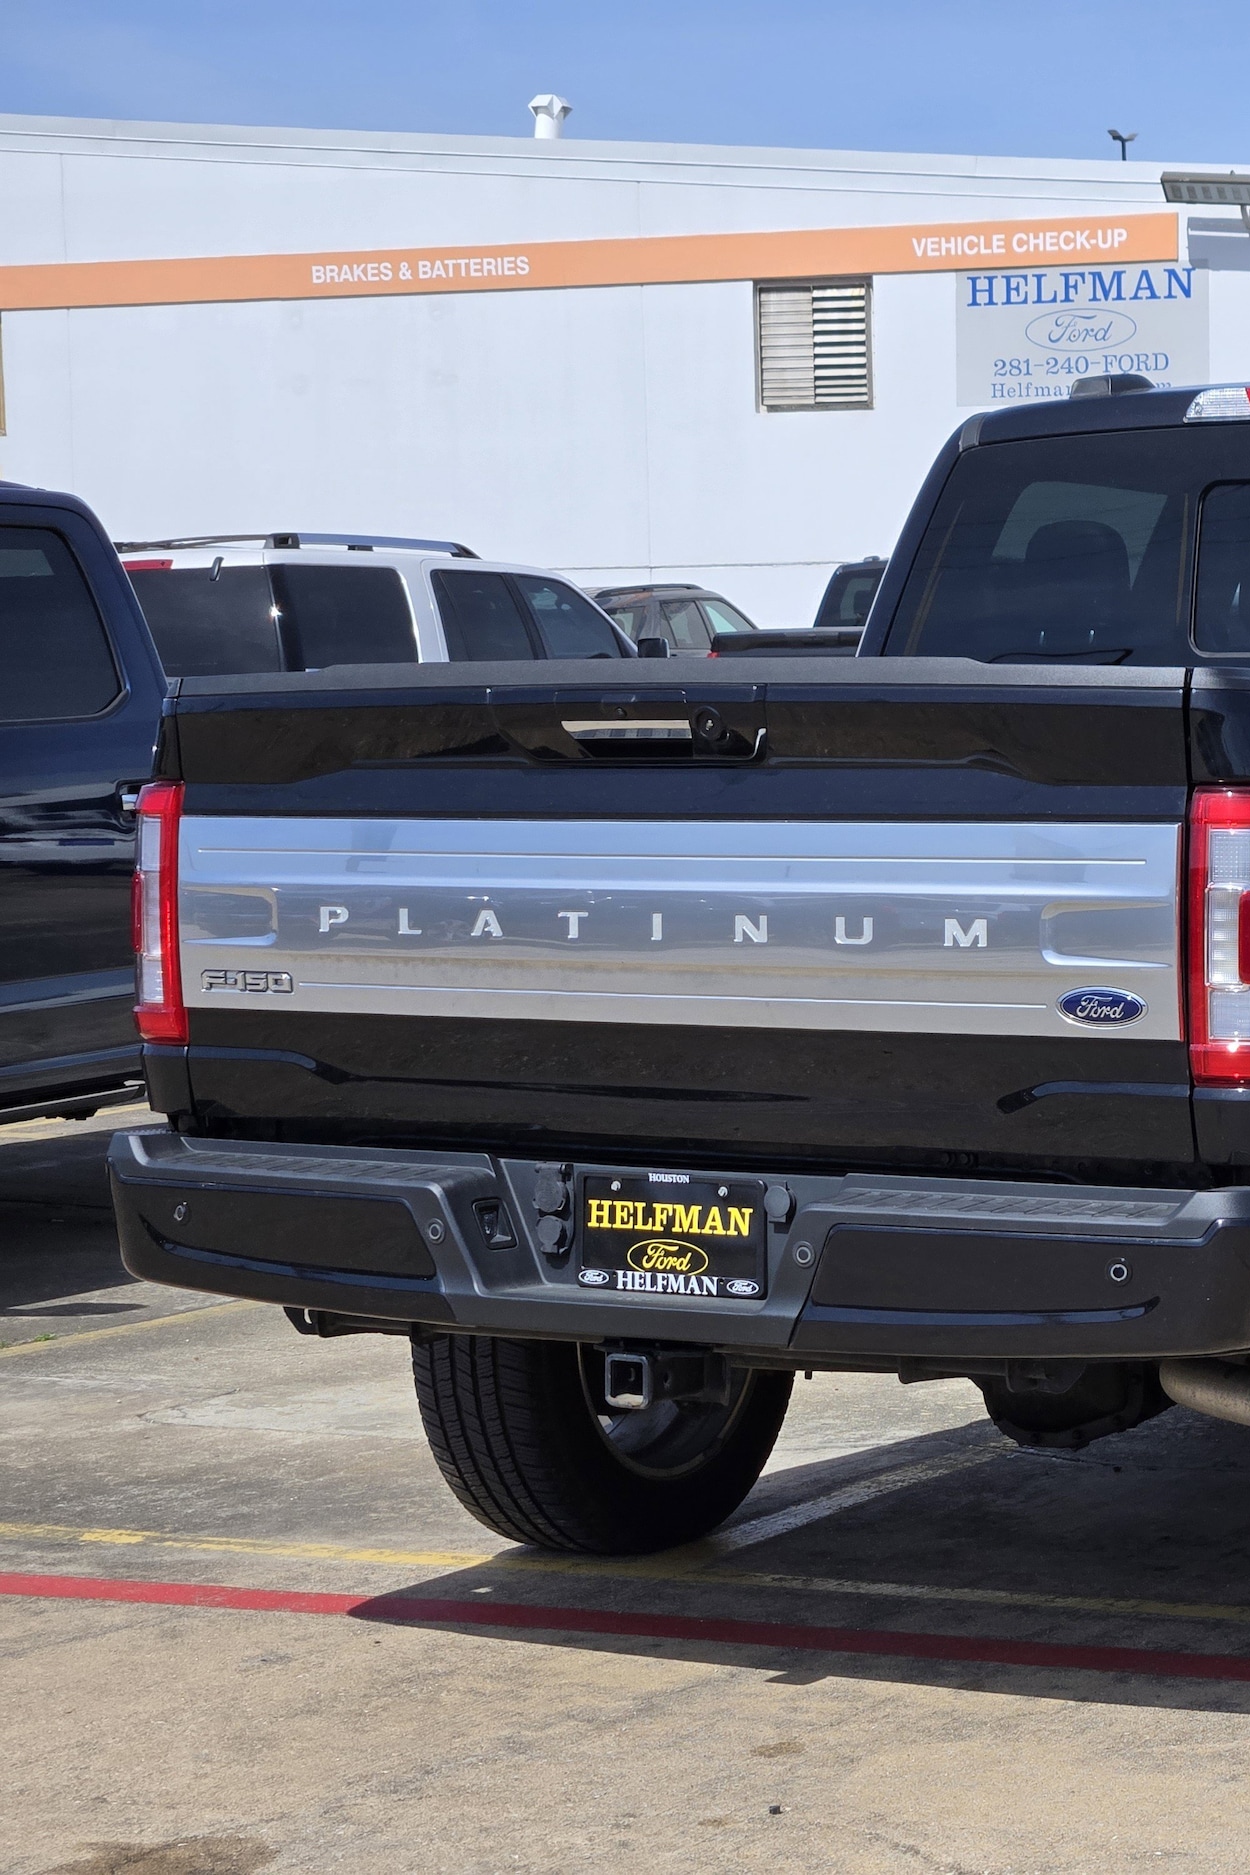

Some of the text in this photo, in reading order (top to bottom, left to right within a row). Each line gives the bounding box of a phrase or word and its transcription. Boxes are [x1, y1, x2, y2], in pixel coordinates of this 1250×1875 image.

[912, 228, 1128, 257] VEHICLE CHECK-UP
[311, 256, 530, 284] BRAKES & BATTERIES
[966, 267, 1196, 307] HELFMAN
[1047, 314, 1113, 344] Ford
[993, 352, 1169, 377] 281-240-FORD
[319, 906, 988, 947] PLATINUM
[201, 969, 294, 994] F-150
[1076, 995, 1125, 1019] Ford
[648, 1173, 690, 1184] HOUSTON
[587, 1199, 753, 1237] HELFMAN
[643, 1243, 692, 1271] Ford
[615, 1270, 718, 1296] HELFMAN
